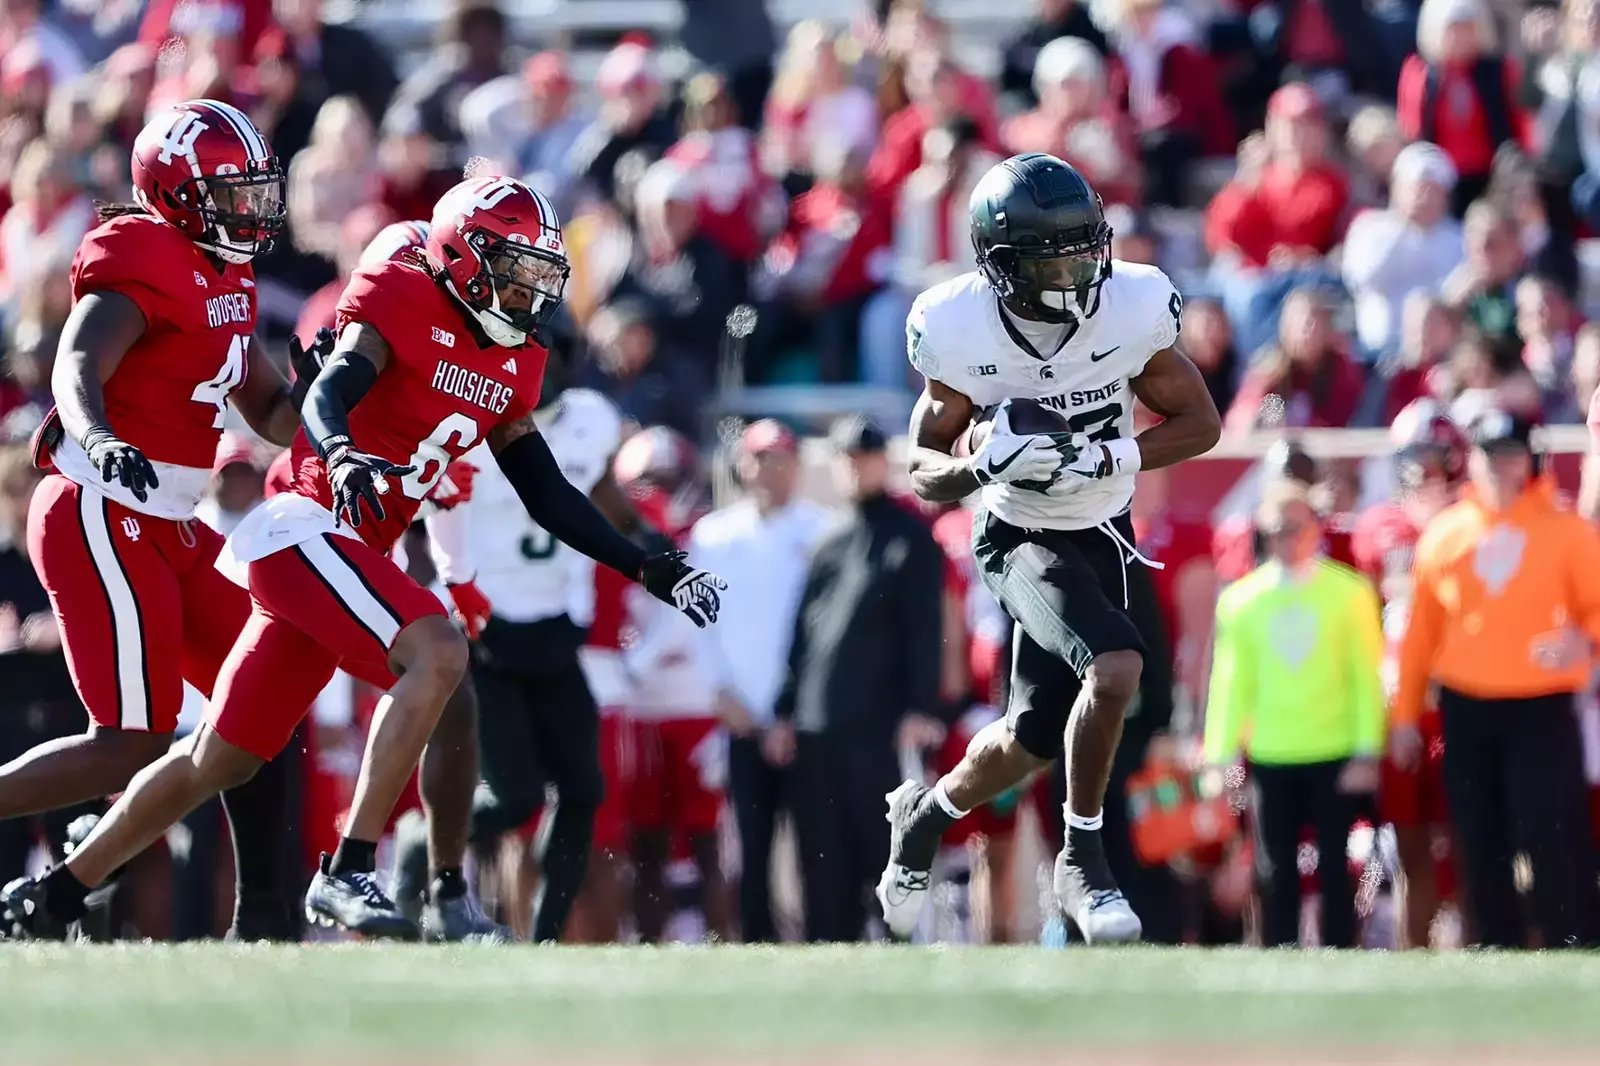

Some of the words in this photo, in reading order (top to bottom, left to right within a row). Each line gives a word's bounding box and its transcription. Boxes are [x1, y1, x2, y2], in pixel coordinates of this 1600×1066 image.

[431, 359, 513, 414] HOOSIERS
[1070, 379, 1121, 406] STATE
[400, 412, 478, 500] 6
